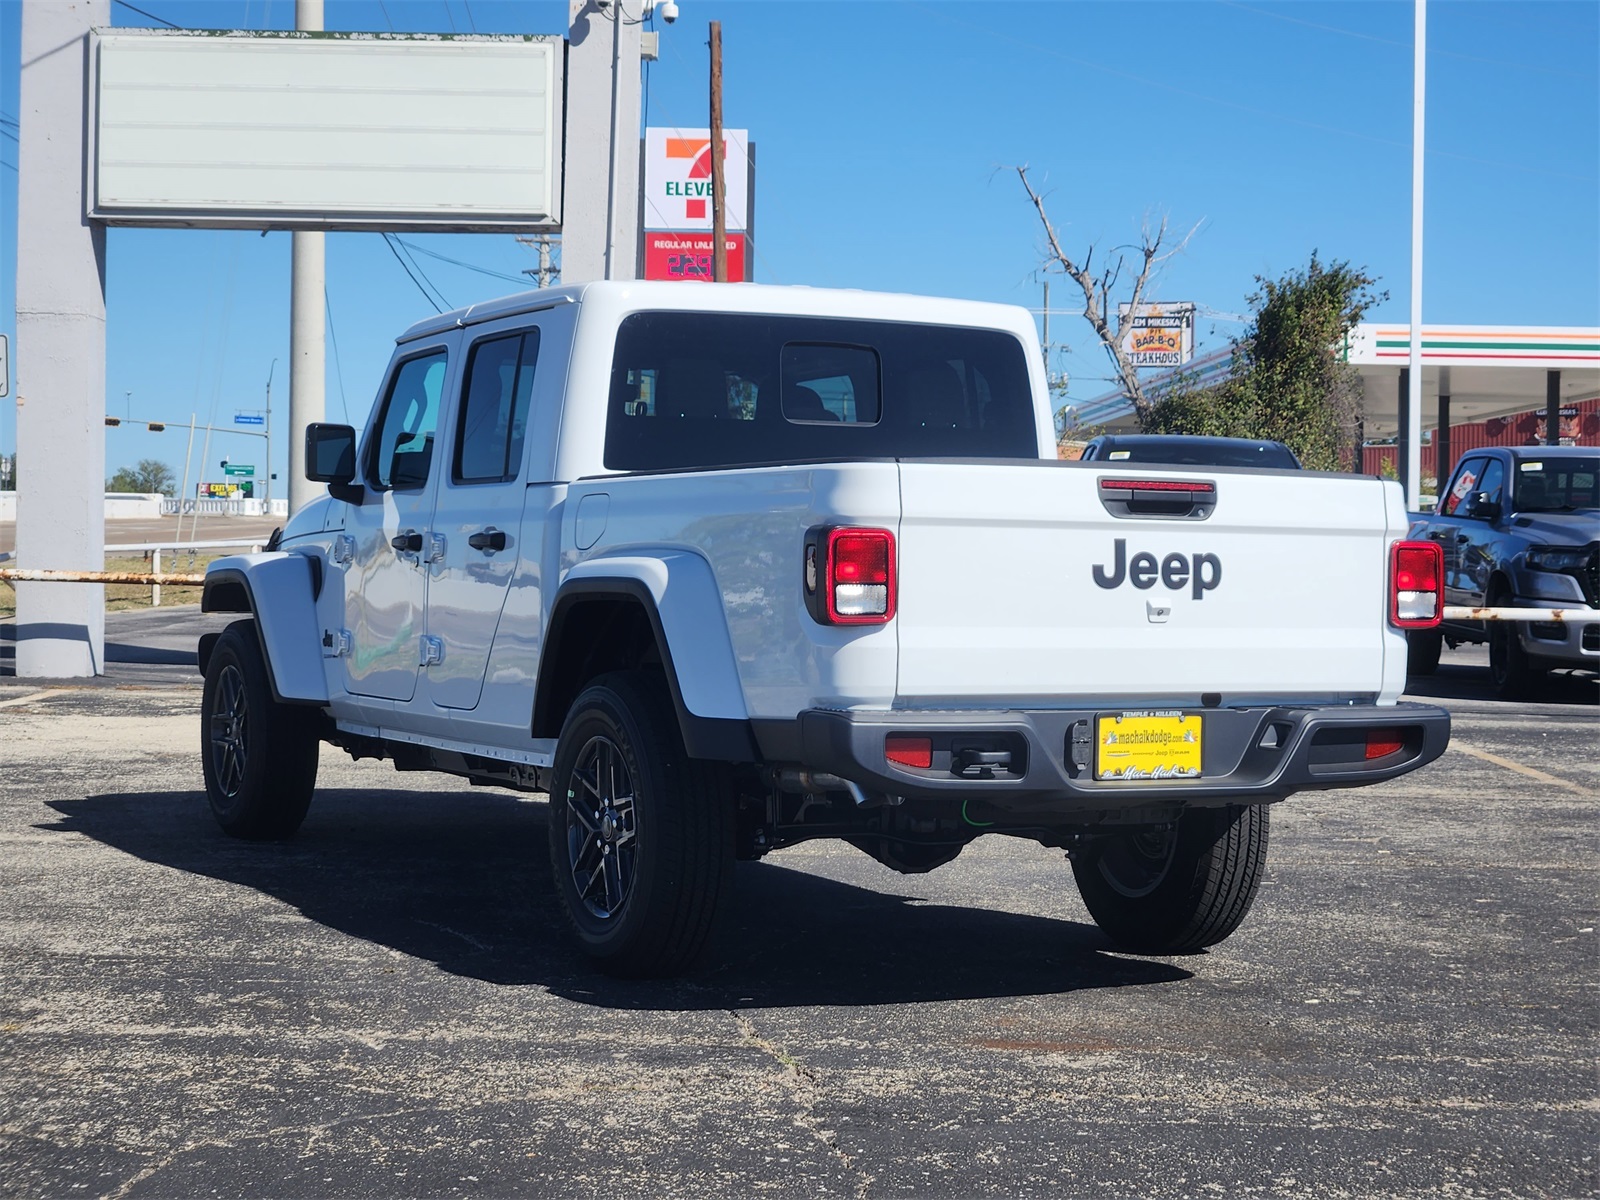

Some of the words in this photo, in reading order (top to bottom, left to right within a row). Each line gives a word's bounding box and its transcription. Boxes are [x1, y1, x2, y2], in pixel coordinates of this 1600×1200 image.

[666, 181, 727, 196] ELEVE
[654, 240, 692, 249] REGULAR
[694, 241, 737, 250] UNLEED
[1136, 335, 1176, 348] BAR-B-Q
[1126, 352, 1179, 364] TEAKHOUS
[1092, 538, 1222, 600] Jeep
[1118, 729, 1183, 746] machaikdodge.com
[1122, 765, 1148, 780] Mac
[1151, 764, 1180, 780] Haik
